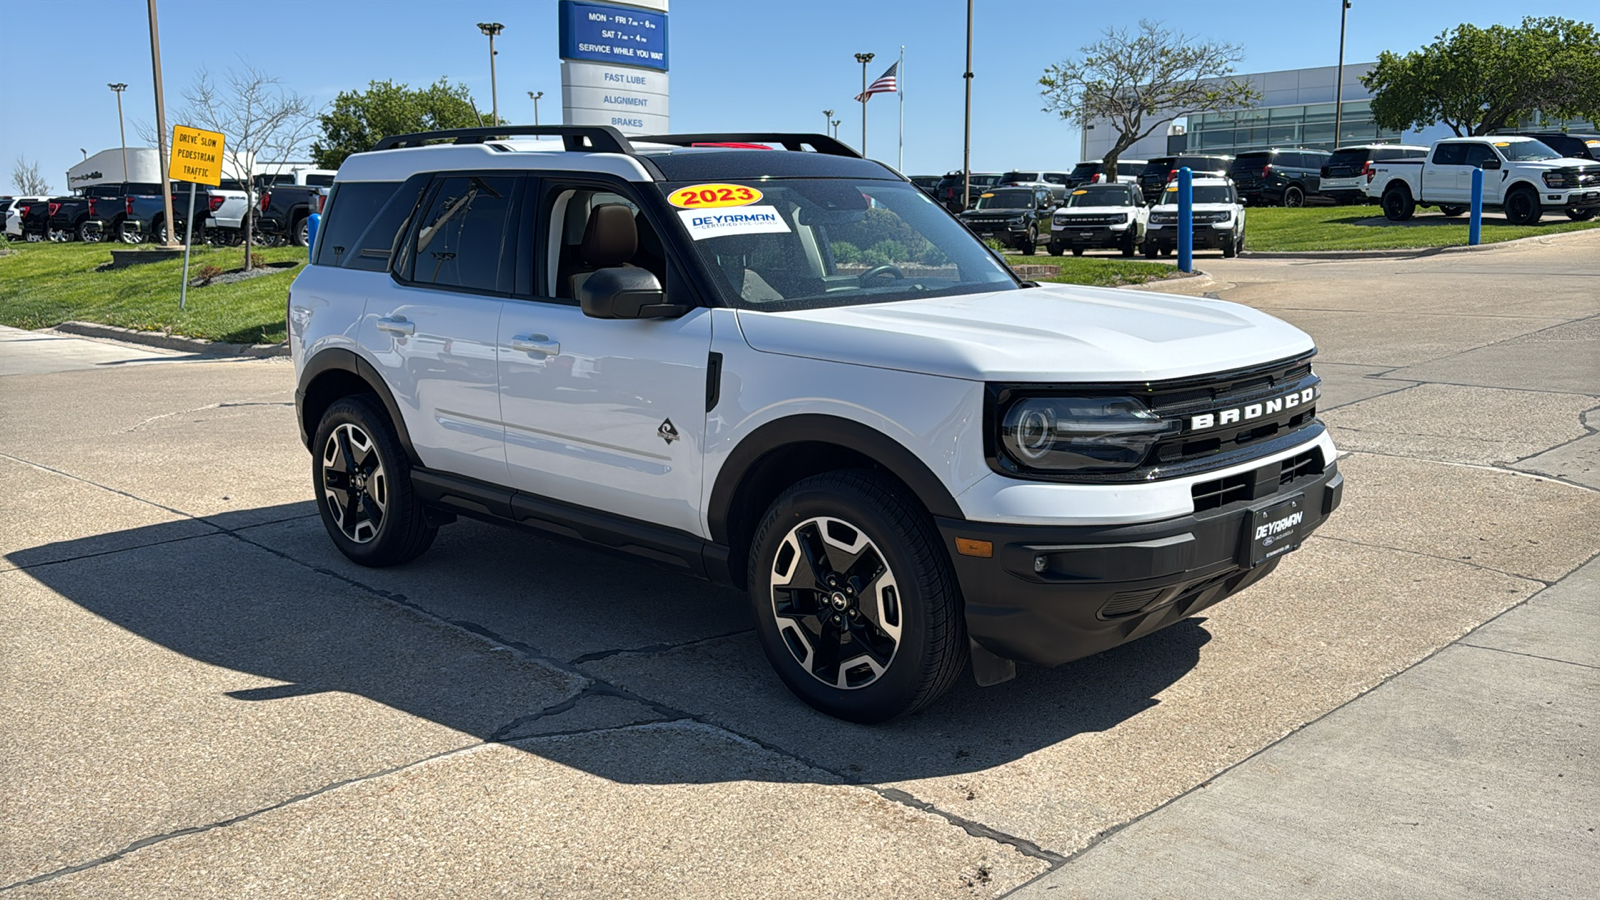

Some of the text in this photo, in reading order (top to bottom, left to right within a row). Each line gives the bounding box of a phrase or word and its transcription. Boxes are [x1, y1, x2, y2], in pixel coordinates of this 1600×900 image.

[588, 12, 607, 22] MON
[615, 15, 627, 25] FRI
[602, 30, 616, 39] SAT
[578, 43, 664, 60] SERVICE WHILE YOU WAIT
[604, 72, 646, 85] FAST LUBE
[603, 95, 648, 107] ALIGNMENT
[611, 117, 643, 128] BRAKES
[179, 133, 217, 148] DRIVE SLOW
[177, 148, 216, 163] PEDESTRIAN
[183, 165, 209, 177] TRAFFIC
[680, 187, 755, 206] 2023
[692, 213, 776, 227] DEYARMAN
[1191, 387, 1314, 431] BRONCO
[1254, 510, 1304, 541] DEYARMAN
